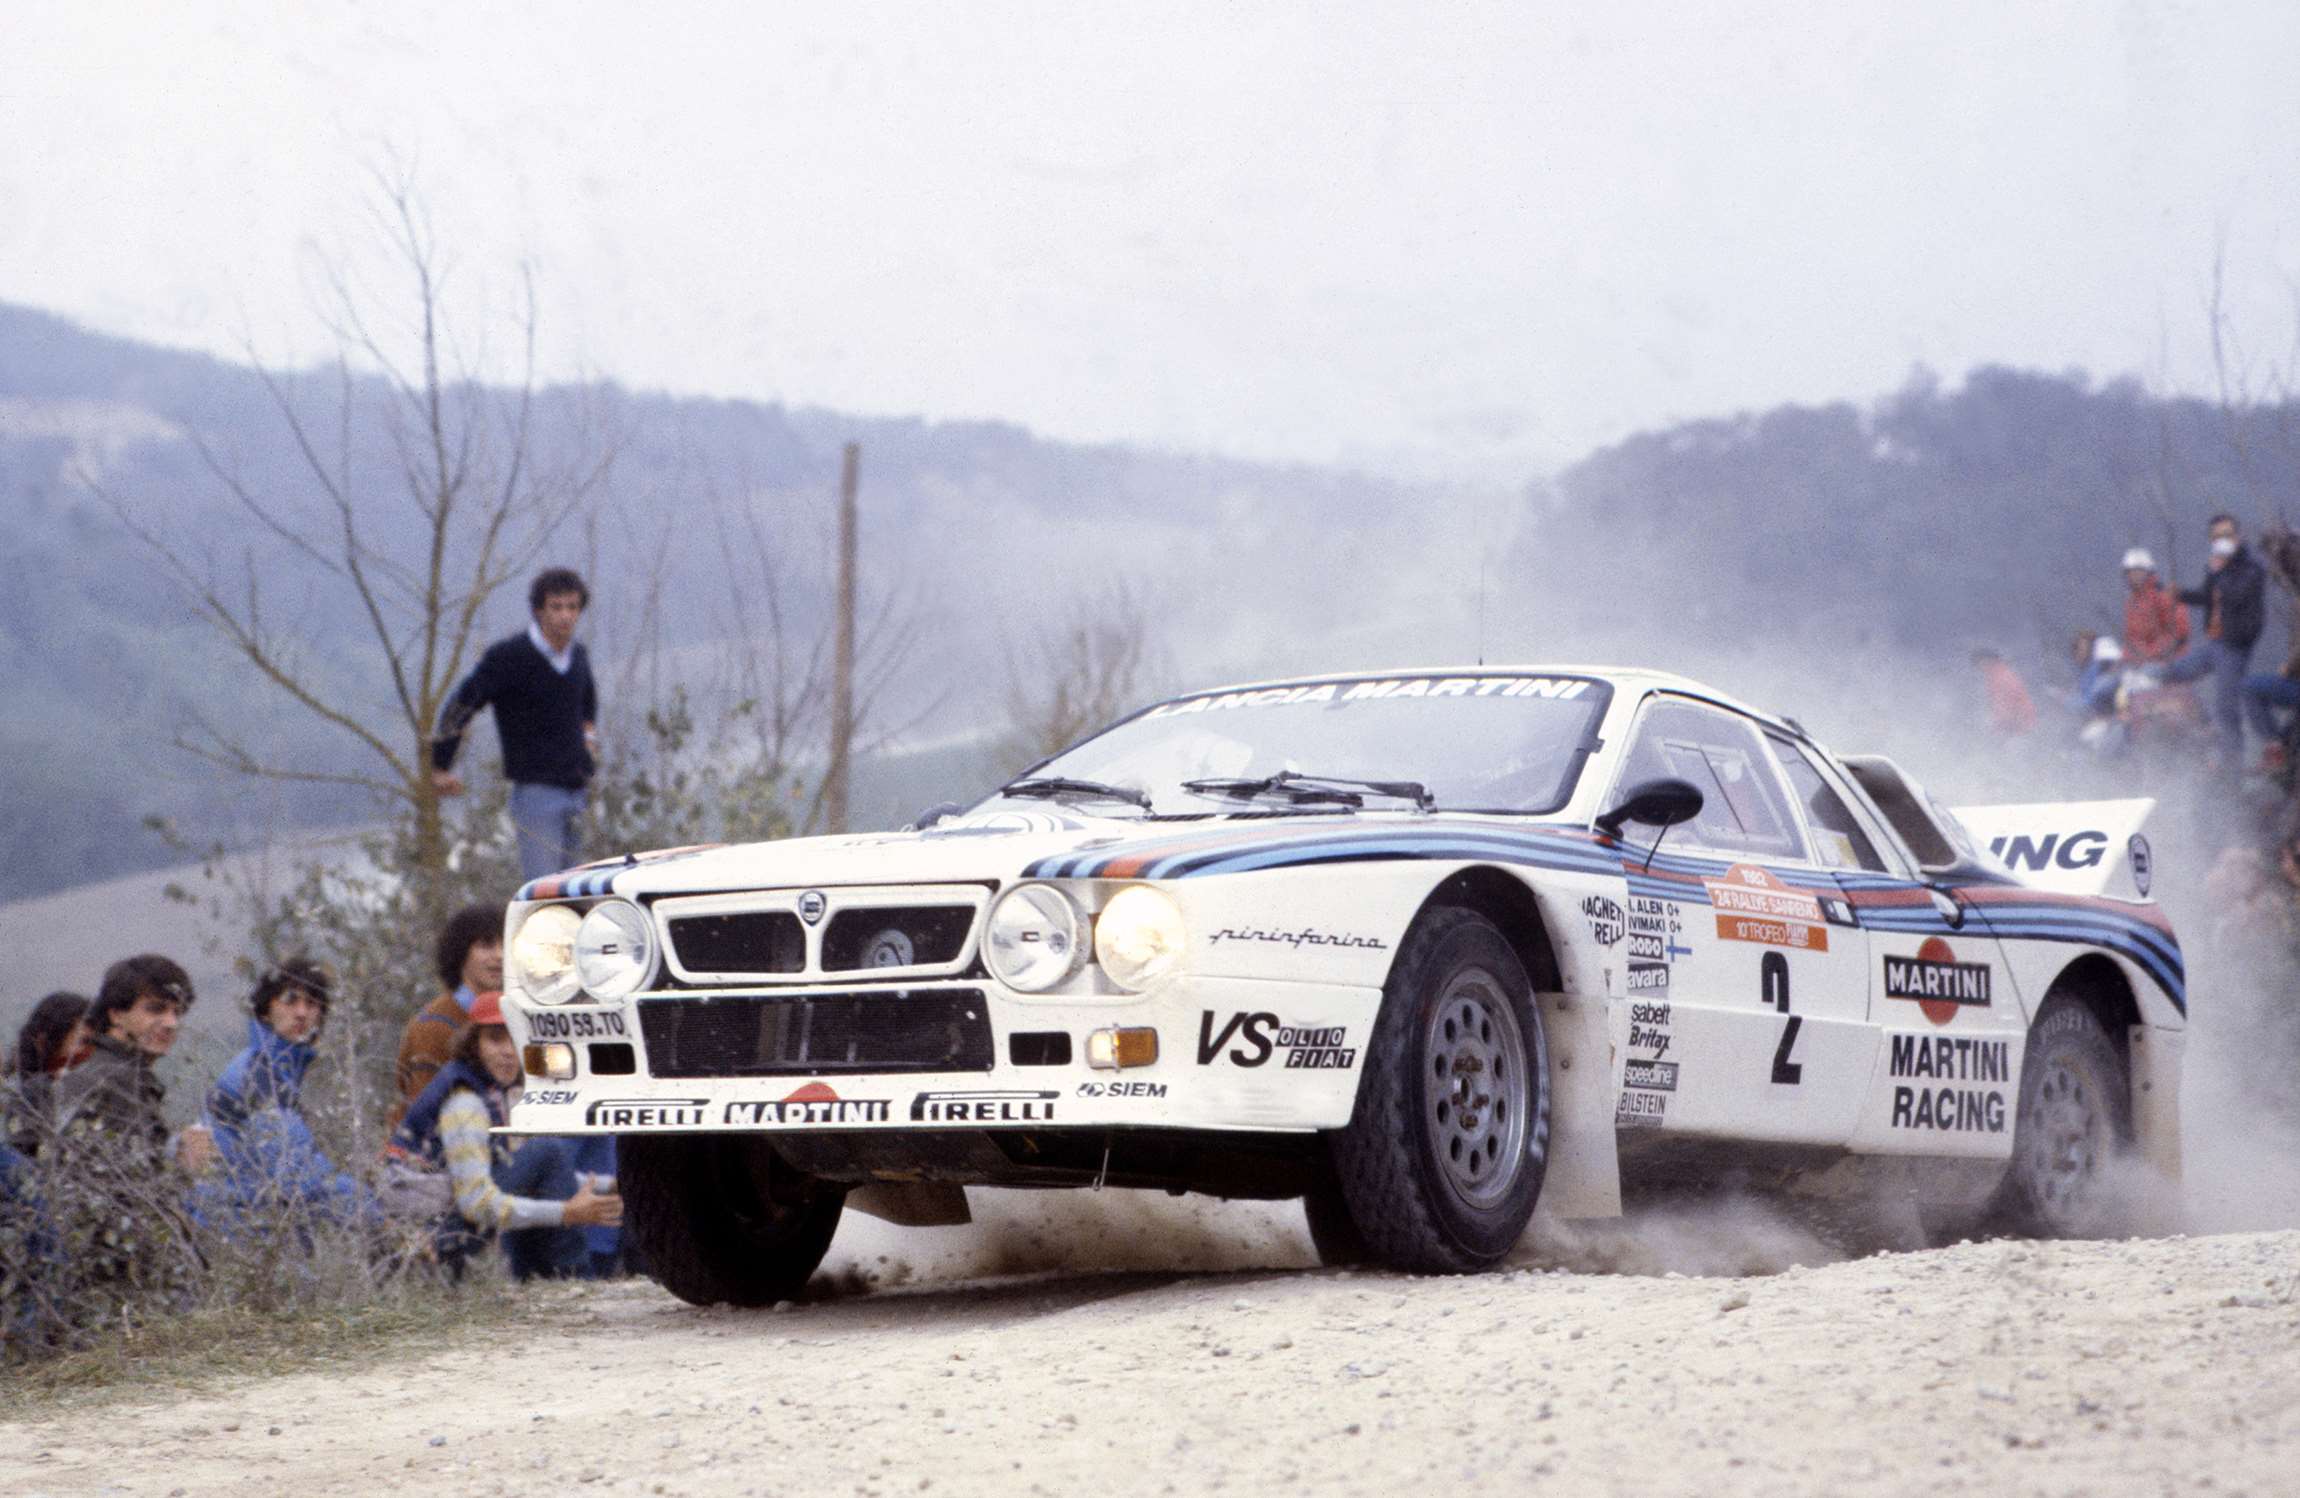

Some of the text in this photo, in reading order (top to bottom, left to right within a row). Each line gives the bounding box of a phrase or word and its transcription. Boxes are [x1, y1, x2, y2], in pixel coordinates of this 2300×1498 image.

[1148, 678, 1590, 720] LANCIA MARTINI
[1637, 900, 1664, 915] ALEN
[1209, 926, 1388, 949] pininfarina
[1627, 967, 1667, 990] avara
[1888, 962, 1987, 1000] MARTINI
[1631, 1001, 1671, 1025] sabelt
[1761, 951, 1803, 1085] 2
[1197, 1009, 1280, 1068] VS
[1278, 1028, 1344, 1046] OLIO
[1628, 1025, 1671, 1059] Britax
[1288, 1050, 1354, 1068] FIAT
[1889, 1034, 2009, 1082] MARTINI
[536, 1089, 578, 1105] SIEM
[1106, 1082, 1168, 1098] SIEM
[727, 1102, 885, 1123] MARTINI
[910, 1091, 1060, 1121] PIRELLI
[1619, 1091, 1667, 1115] BILSTEIN
[1891, 1086, 2005, 1132] RACING
